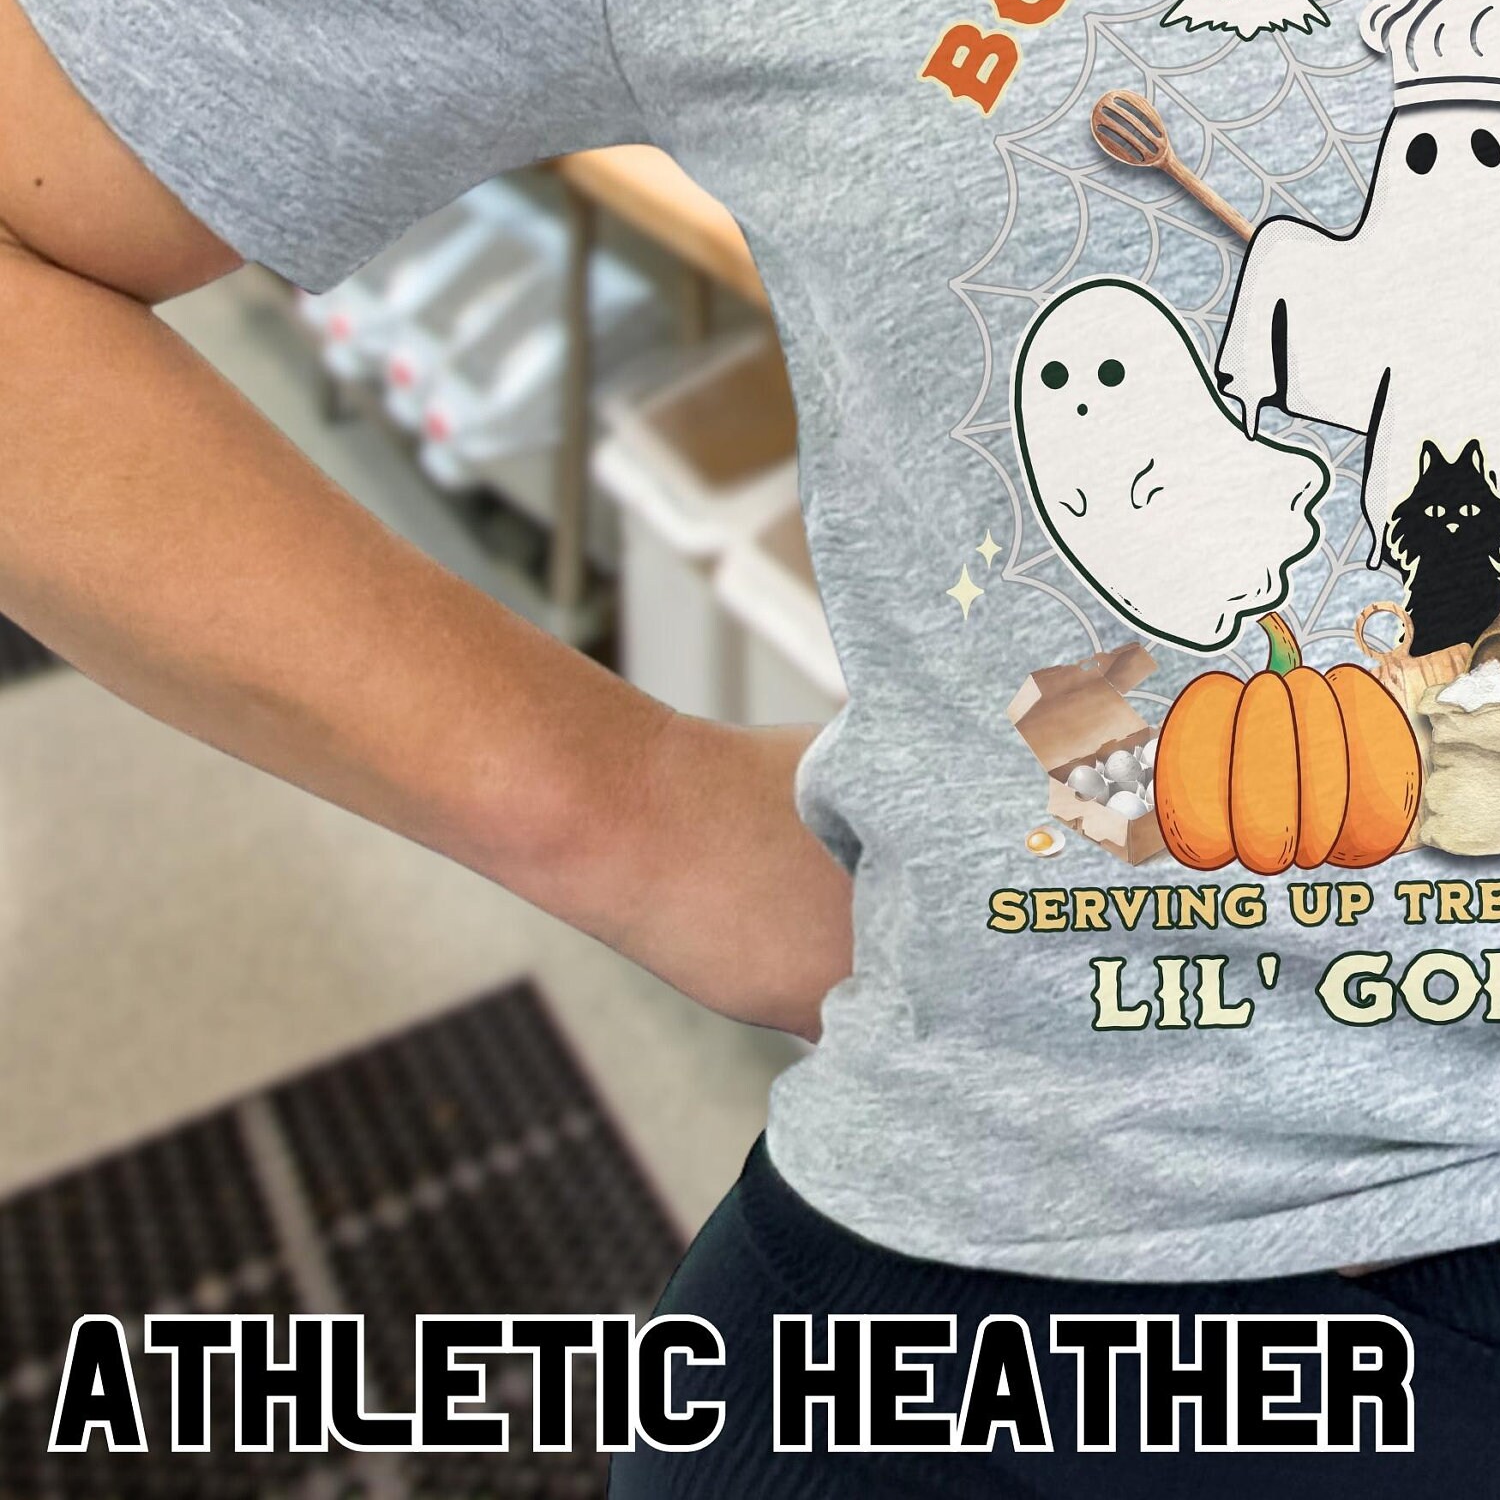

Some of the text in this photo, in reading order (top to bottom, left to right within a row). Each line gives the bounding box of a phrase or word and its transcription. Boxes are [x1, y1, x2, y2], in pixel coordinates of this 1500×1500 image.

[989, 884, 1265, 933] SERVING
[1290, 881, 1374, 927] UP
[1088, 954, 1281, 1031] LIL'
